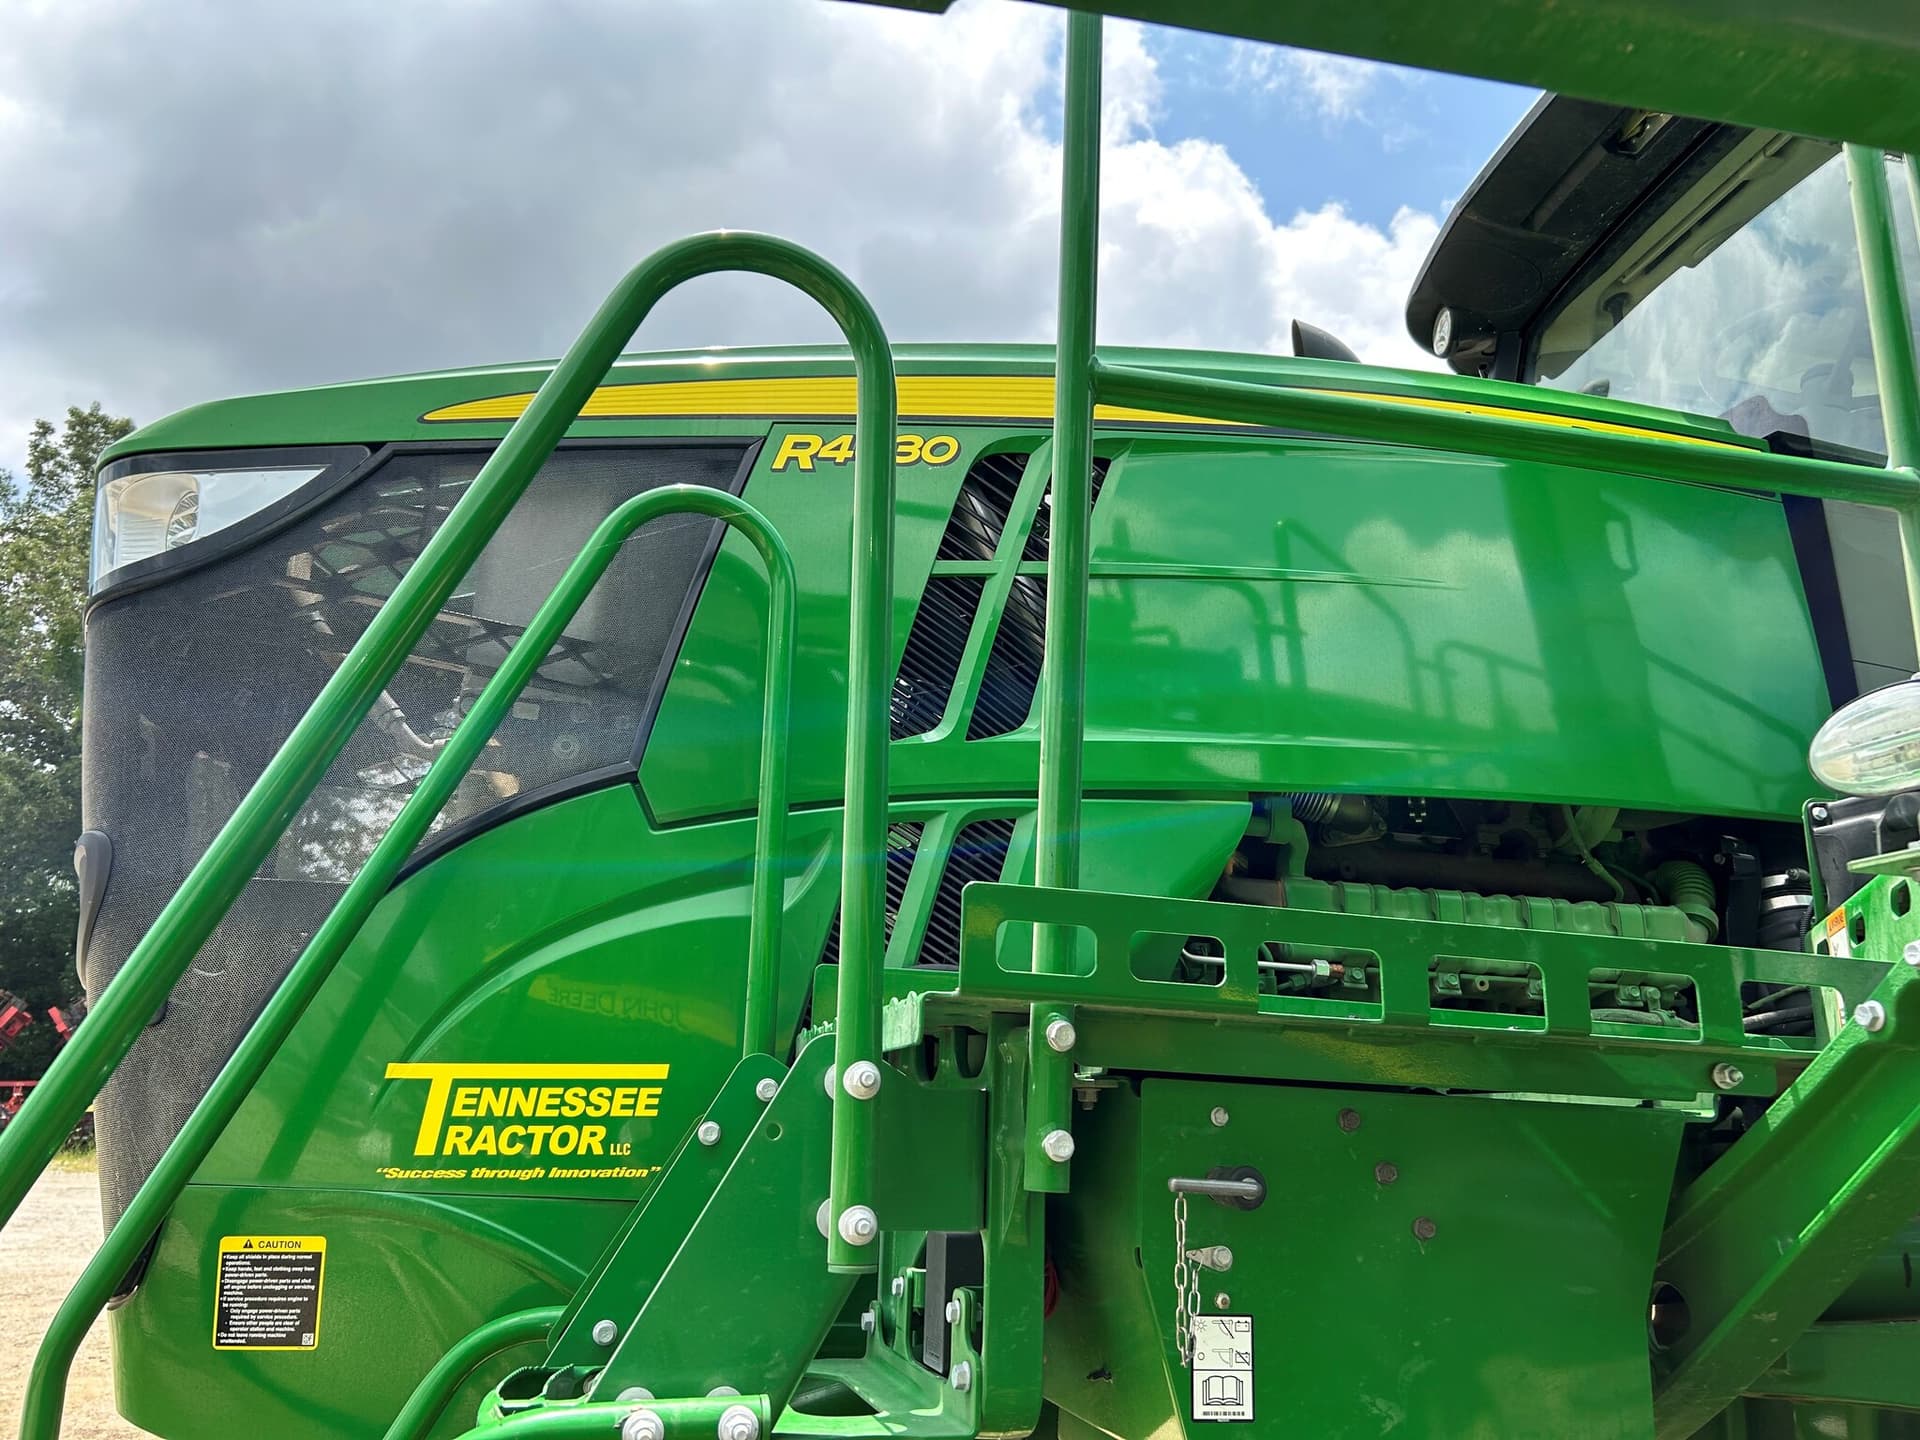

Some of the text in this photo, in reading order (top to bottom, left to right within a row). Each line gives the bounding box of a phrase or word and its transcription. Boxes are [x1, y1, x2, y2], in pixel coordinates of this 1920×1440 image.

[771, 433, 960, 471] R430
[384, 1063, 670, 1118] TENNESSEE
[610, 1143, 631, 1156] LLC
[471, 1166, 546, 1181] through
